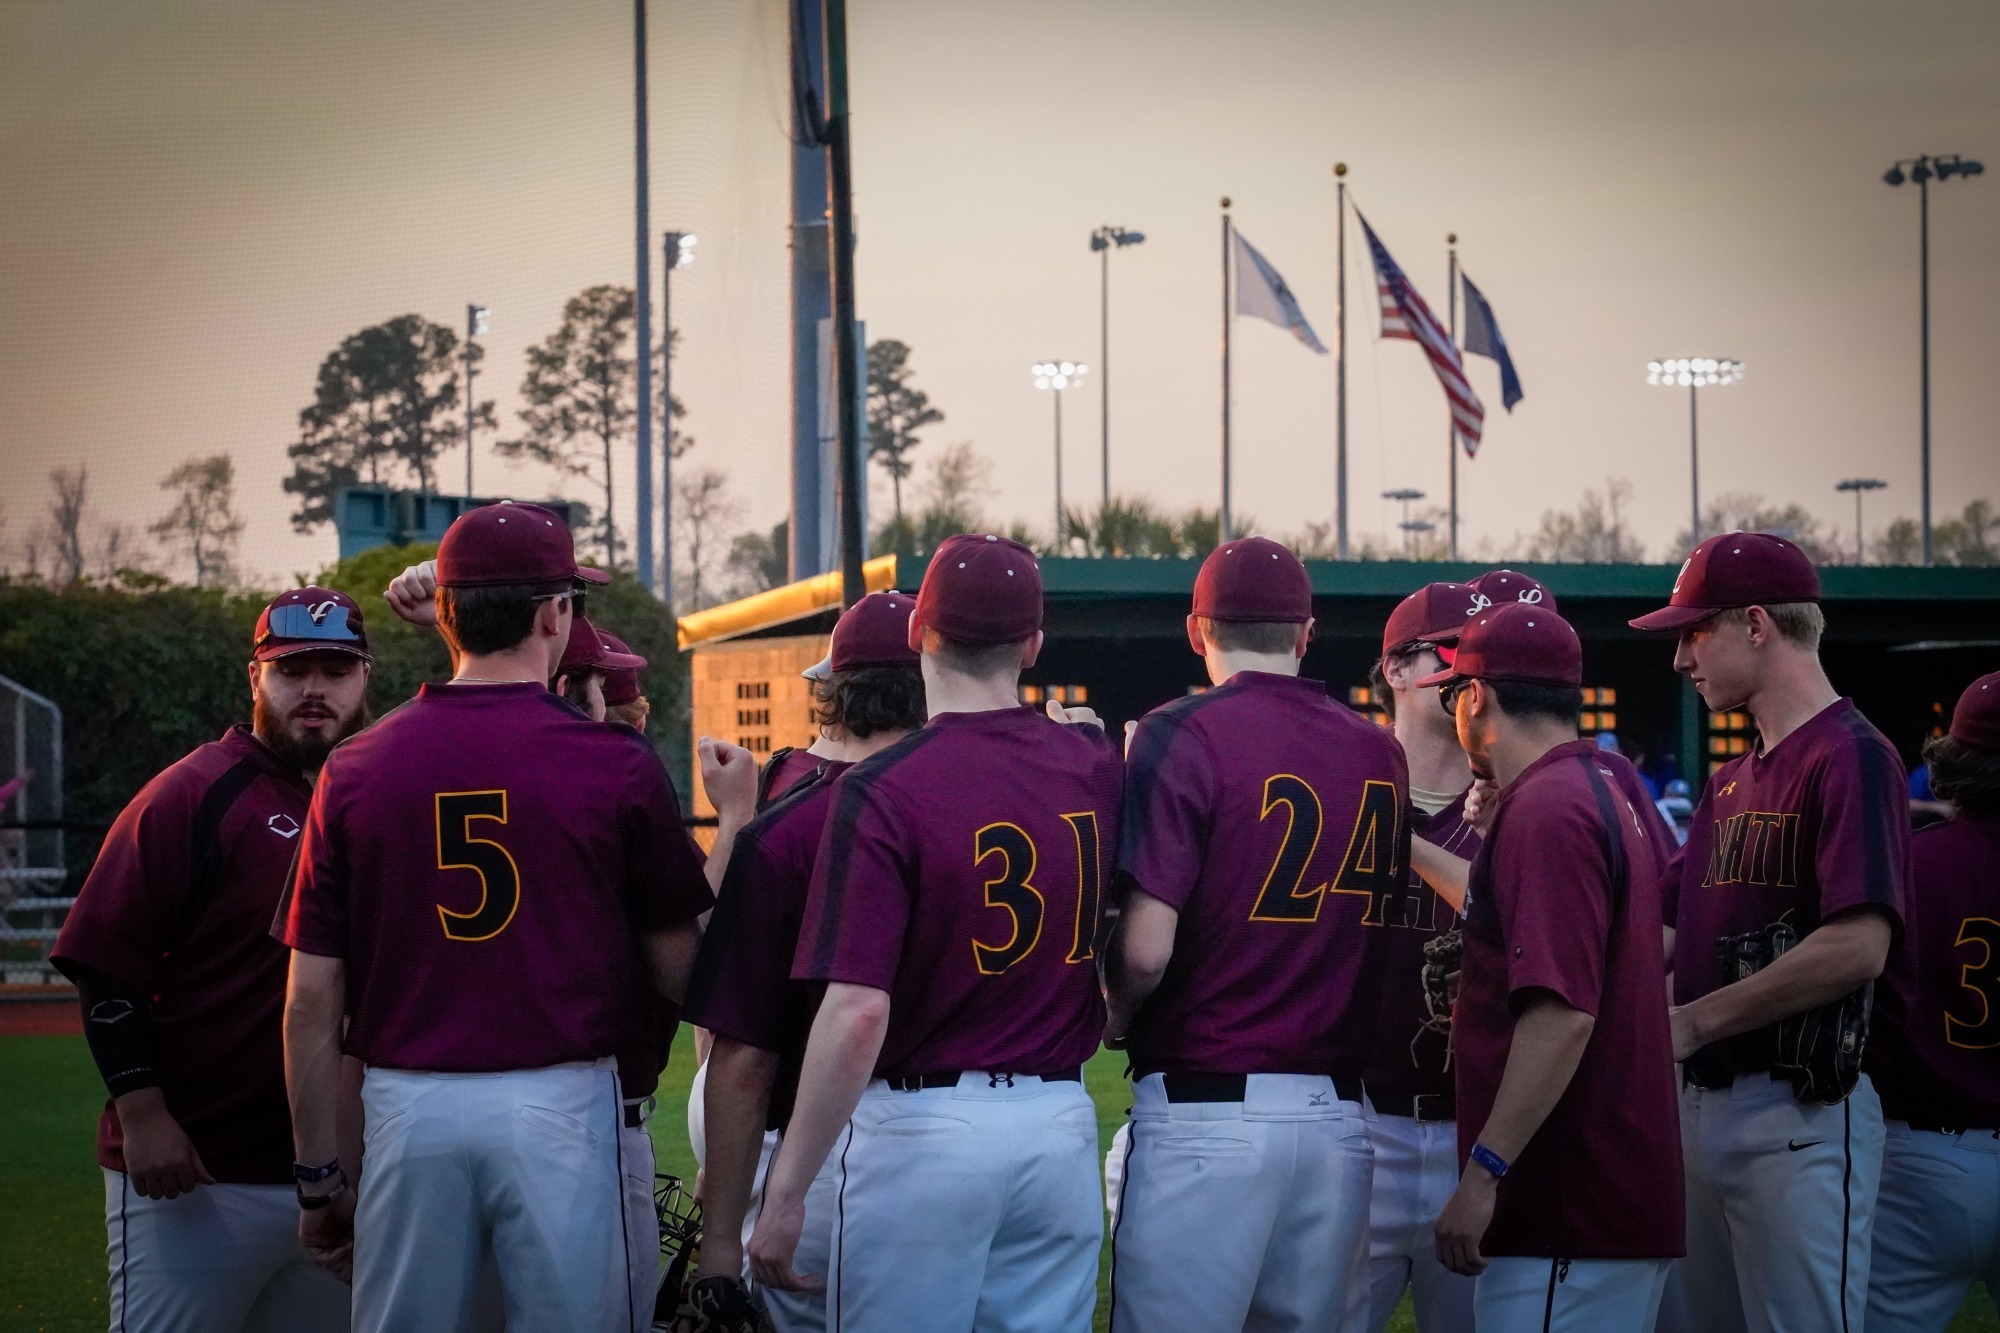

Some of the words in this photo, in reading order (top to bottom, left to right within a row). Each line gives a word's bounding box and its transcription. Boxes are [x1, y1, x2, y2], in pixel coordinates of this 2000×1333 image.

[434, 789, 521, 941] 5
[971, 810, 1101, 975] 31
[1249, 773, 1398, 926] 24
[1701, 811, 1800, 888] NHTI
[1944, 916, 2000, 1050] 3
